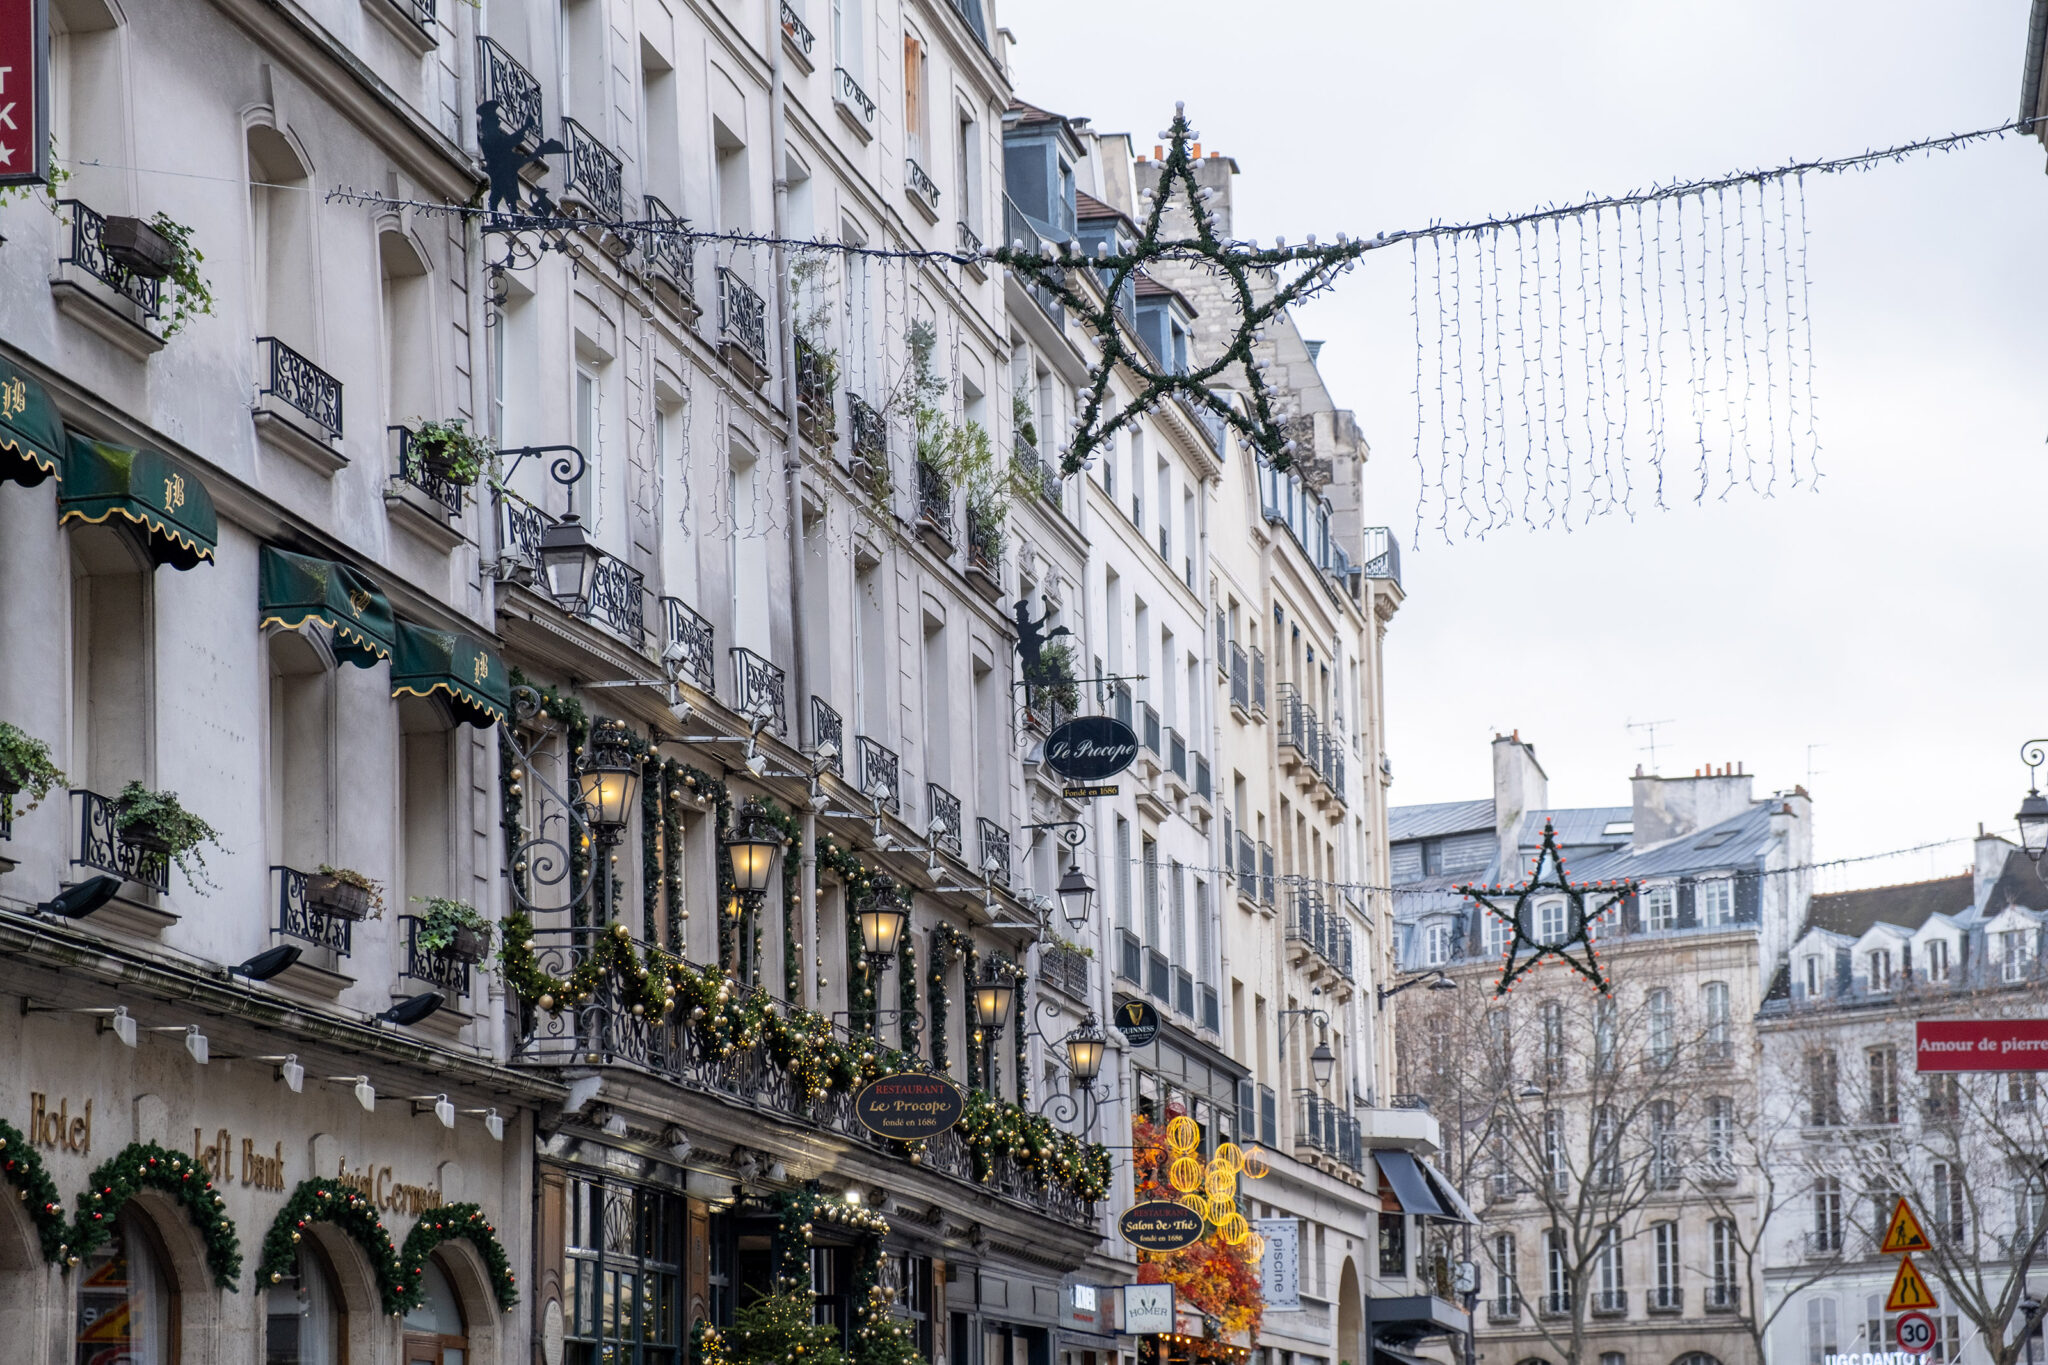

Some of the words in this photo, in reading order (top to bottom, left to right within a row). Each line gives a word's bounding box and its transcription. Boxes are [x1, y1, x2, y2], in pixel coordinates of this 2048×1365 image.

[1049, 741, 1071, 760] Le
[1073, 739, 1135, 763] Procope
[1100, 787, 1117, 795] 1686
[1119, 1025, 1155, 1035] GUINNESS
[1918, 1038, 1974, 1052] Amour
[1977, 1037, 1997, 1051] de
[875, 1084, 945, 1095] RESTAURANT
[869, 1100, 890, 1112] Le
[893, 1100, 951, 1115] Procope
[31, 1092, 92, 1153] Hotel
[882, 1117, 904, 1127] fondé
[918, 1118, 936, 1126] 1686
[242, 1138, 285, 1190] Bank
[377, 1166, 442, 1216] Germain
[1133, 1209, 1188, 1217] RESTAURANT
[1125, 1220, 1154, 1233] Salon
[1156, 1219, 1172, 1230] de
[1173, 1219, 1198, 1230] Thé
[1139, 1234, 1156, 1242] fondé
[1167, 1234, 1183, 1242] 1686
[1271, 1238, 1285, 1293] piscine
[1129, 1304, 1168, 1319] HOMER
[1903, 1323, 1929, 1343] 30
